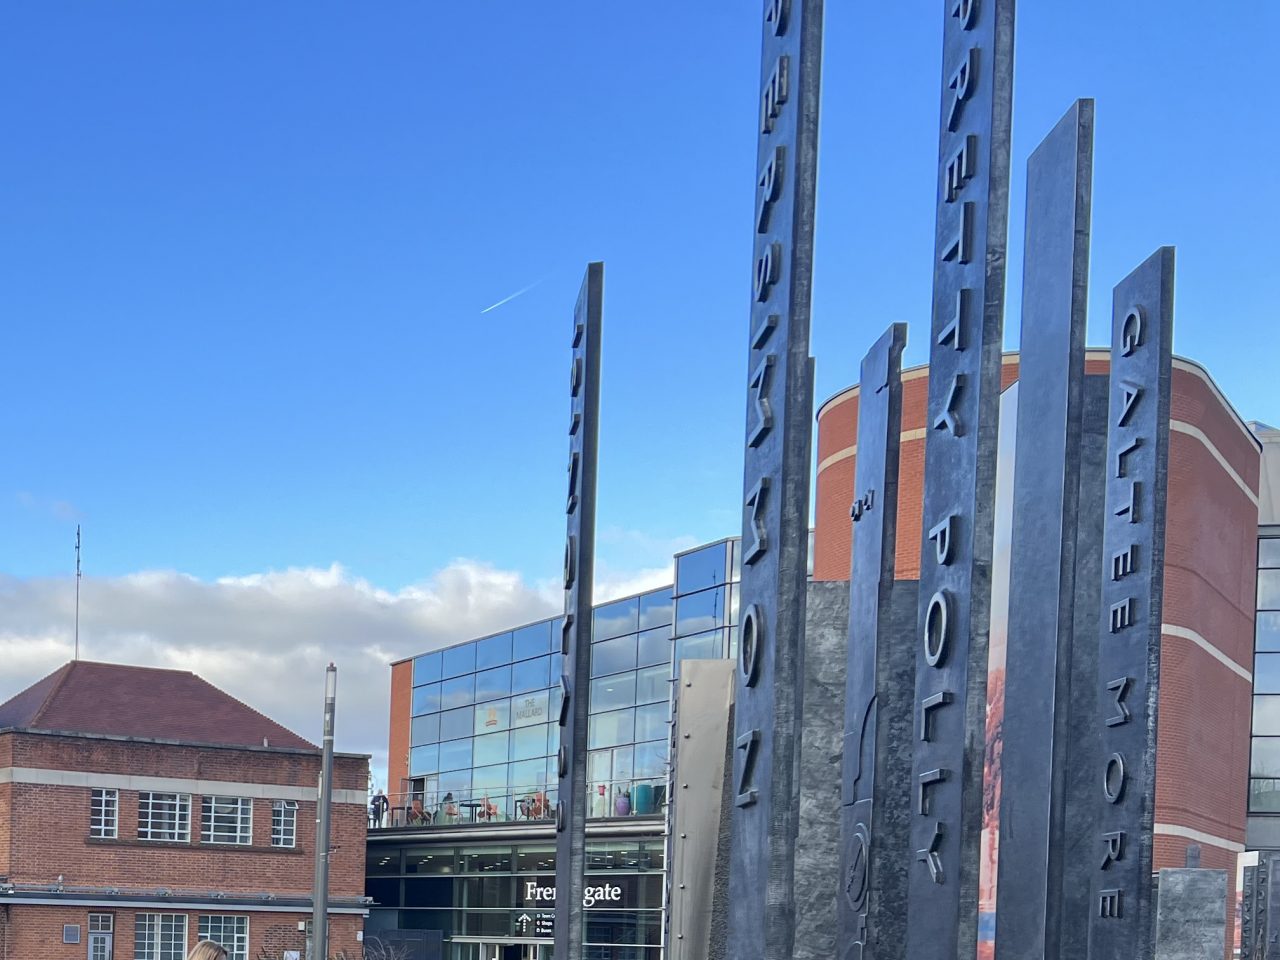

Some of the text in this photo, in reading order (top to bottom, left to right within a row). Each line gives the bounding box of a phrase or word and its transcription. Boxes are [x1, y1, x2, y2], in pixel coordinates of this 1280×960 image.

[916, 515, 956, 884] POLLY
[1099, 305, 1146, 918] GALTEE MORE
[525, 882, 621, 907] Fregate
